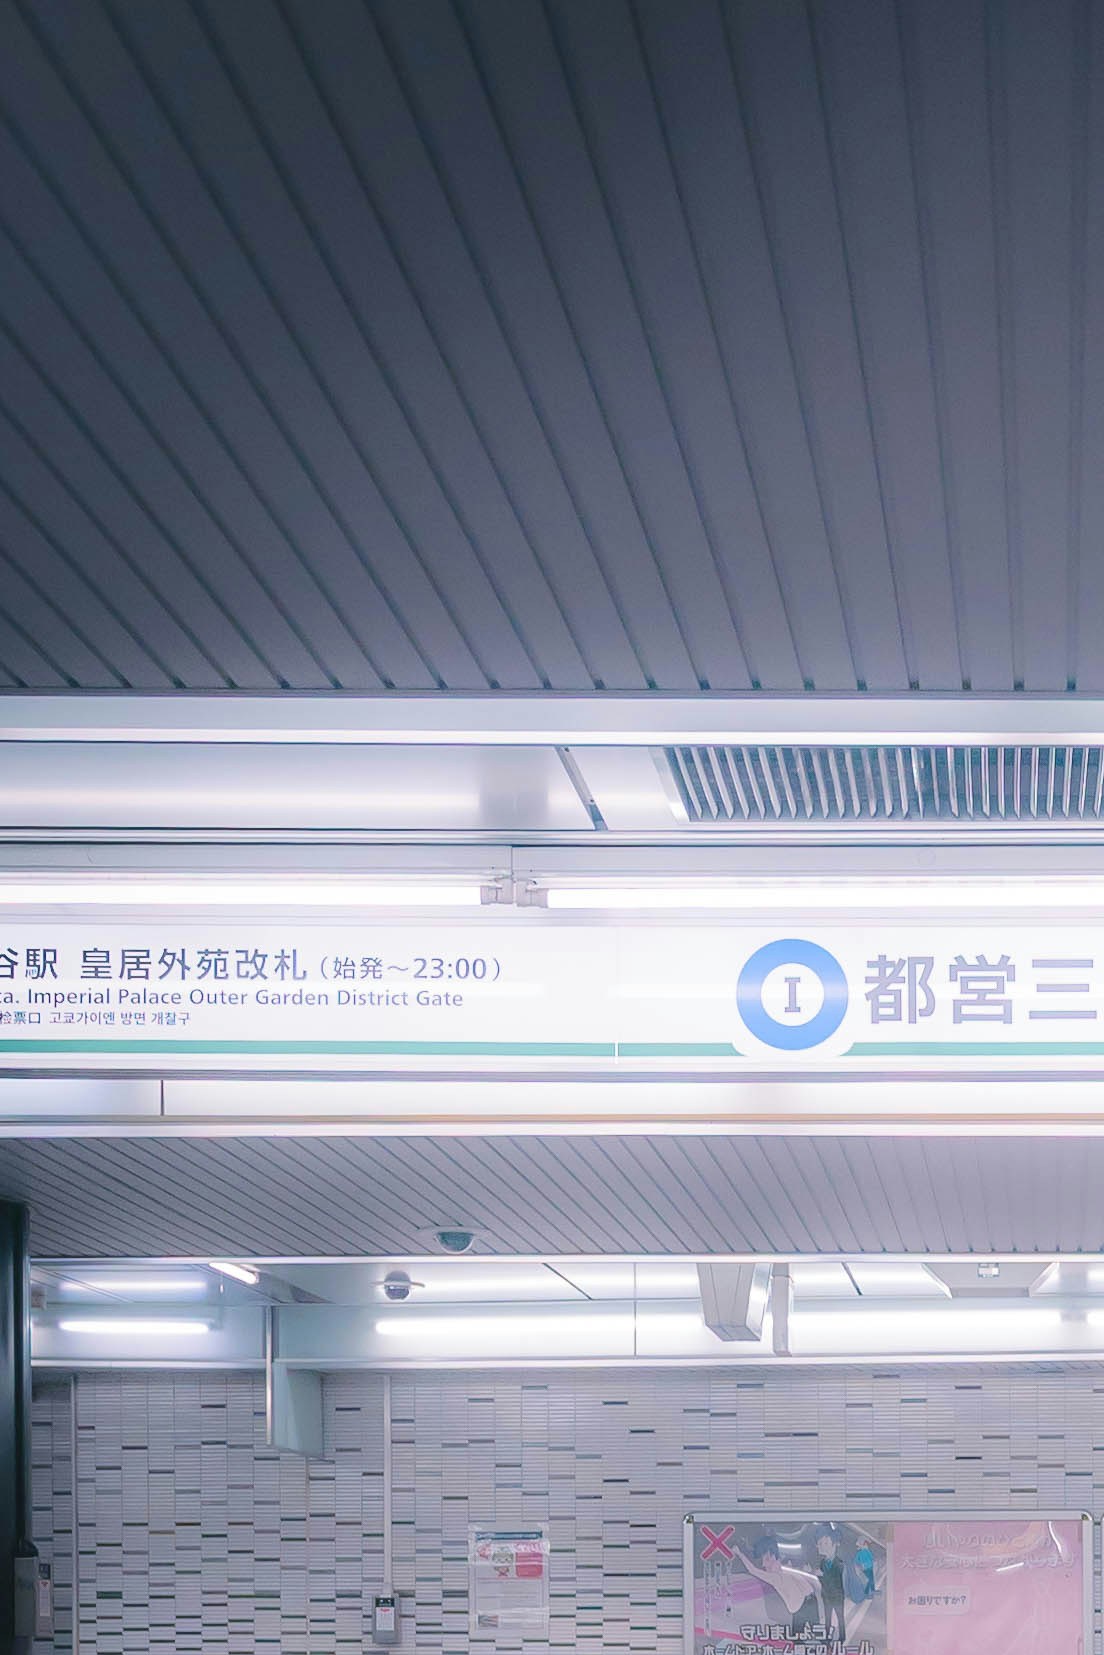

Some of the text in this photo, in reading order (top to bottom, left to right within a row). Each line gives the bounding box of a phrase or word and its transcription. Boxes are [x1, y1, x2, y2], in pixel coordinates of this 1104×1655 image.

[80, 947, 308, 981] 皇居外苑改札
[27, 988, 110, 1008] Imperial
[119, 988, 182, 1005] Palace
[190, 988, 248, 1006] Outer
[255, 989, 329, 1006] Garden
[337, 989, 409, 1006] District
[416, 990, 464, 1007] Gate
[121, 1011, 146, 1025] 방면
[151, 1011, 191, 1025] 개찰구
